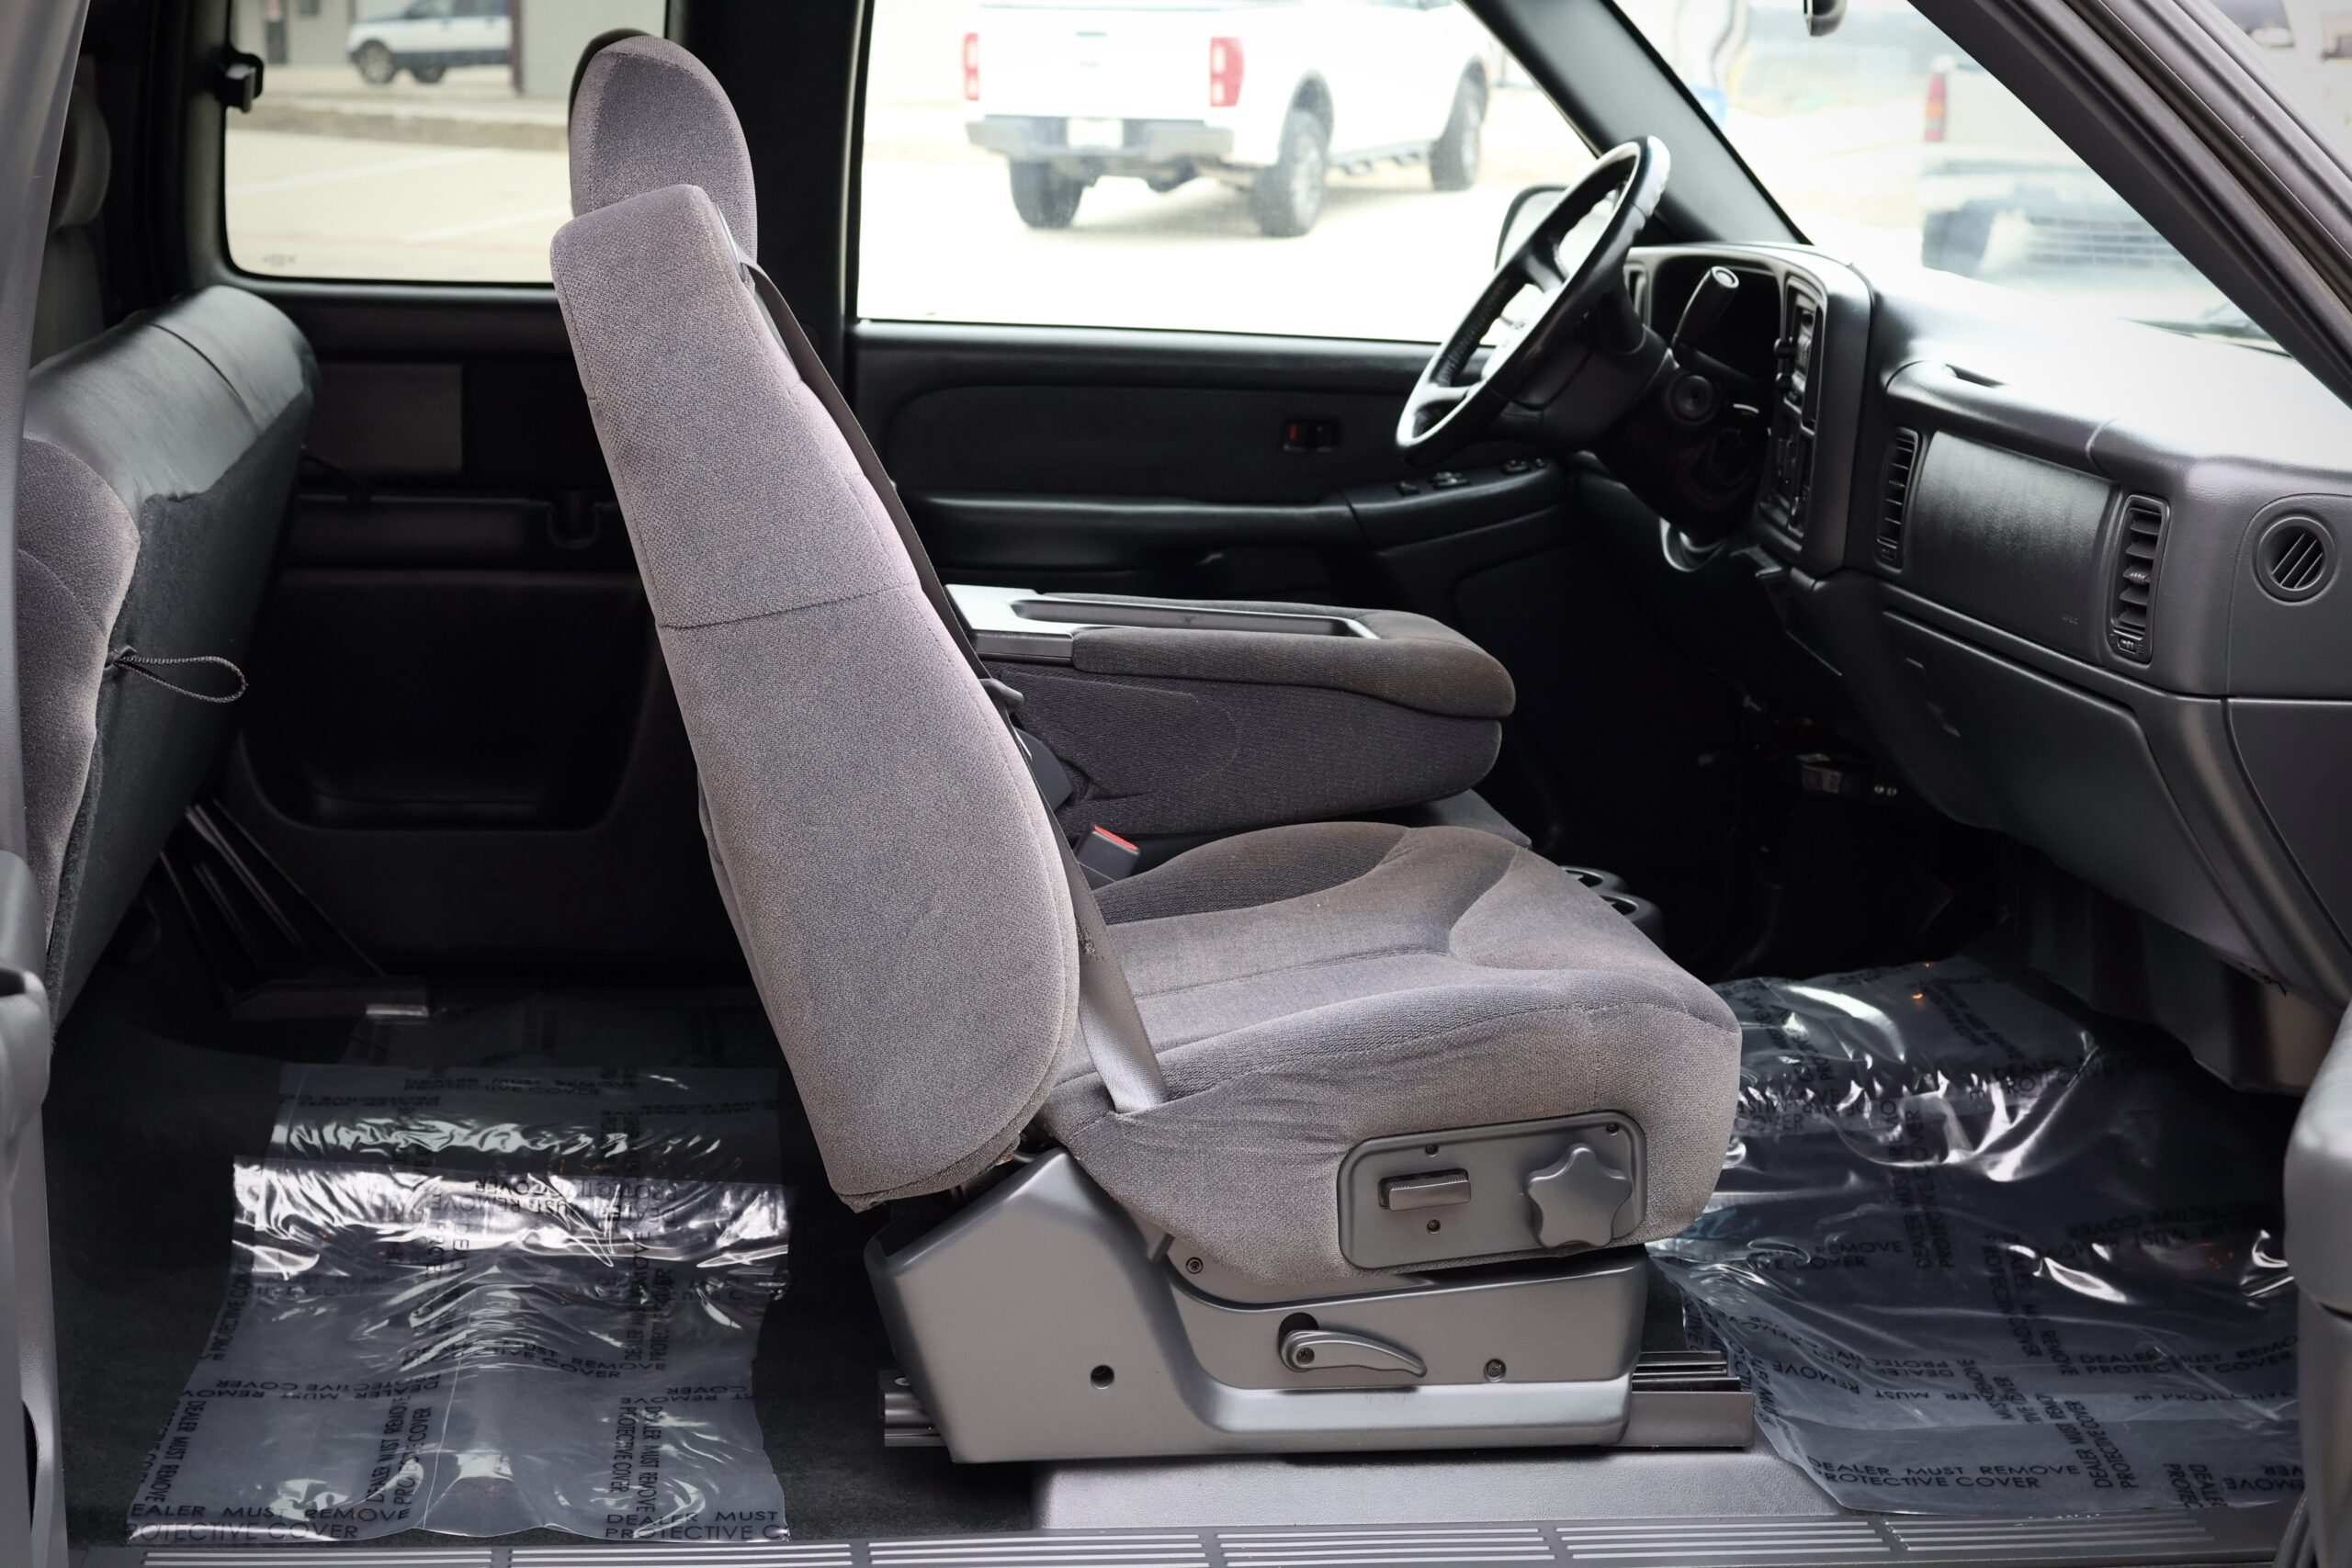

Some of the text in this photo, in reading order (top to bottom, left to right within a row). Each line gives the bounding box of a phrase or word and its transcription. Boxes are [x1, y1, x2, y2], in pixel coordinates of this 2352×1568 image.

[1736, 1114, 1804, 1132] COVER
[1793, 1256, 1868, 1269] COVER
[2009, 1317, 2043, 1359] COVER
[2235, 1336, 2299, 1359] REMO
[2041, 1329, 2080, 1376] REMOVE
[2214, 1351, 2293, 1373] COVER
[542, 1357, 622, 1379] COVER
[572, 1357, 668, 1371] REMOVE
[216, 1380, 300, 1391] COVER
[1772, 1359, 1861, 1395] REMOVE
[184, 1390, 266, 1399] REMOV
[279, 1391, 340, 1400] MUST
[620, 1393, 718, 1405] REMOVE
[666, 1386, 749, 1395] COVER
[1875, 1389, 1930, 1400] MUST
[177, 1400, 207, 1433] DEALER
[408, 1406, 433, 1442] COVER
[165, 1437, 191, 1461] MUST
[2034, 1393, 2113, 1489] DEALER MUST REMO
[2065, 1400, 2140, 1490] PROTECTIVE COVER
[640, 1445, 661, 1469] MUST
[1807, 1455, 2081, 1477] DEALER MUST REMOVE
[609, 1461, 633, 1494] COVER
[2262, 1465, 2304, 1477] VER
[145, 1464, 181, 1503] REMOVE
[636, 1472, 660, 1513] REMOVE
[1955, 1476, 2041, 1489] COVER
[2162, 1463, 2205, 1509] PROTEC
[2222, 1477, 2306, 1492] EMOVE
[131, 1504, 412, 1522] EALER MUST REMOVE
[715, 1511, 778, 1521] MUST
[127, 1521, 359, 1542] ROTECTIVE COVER
